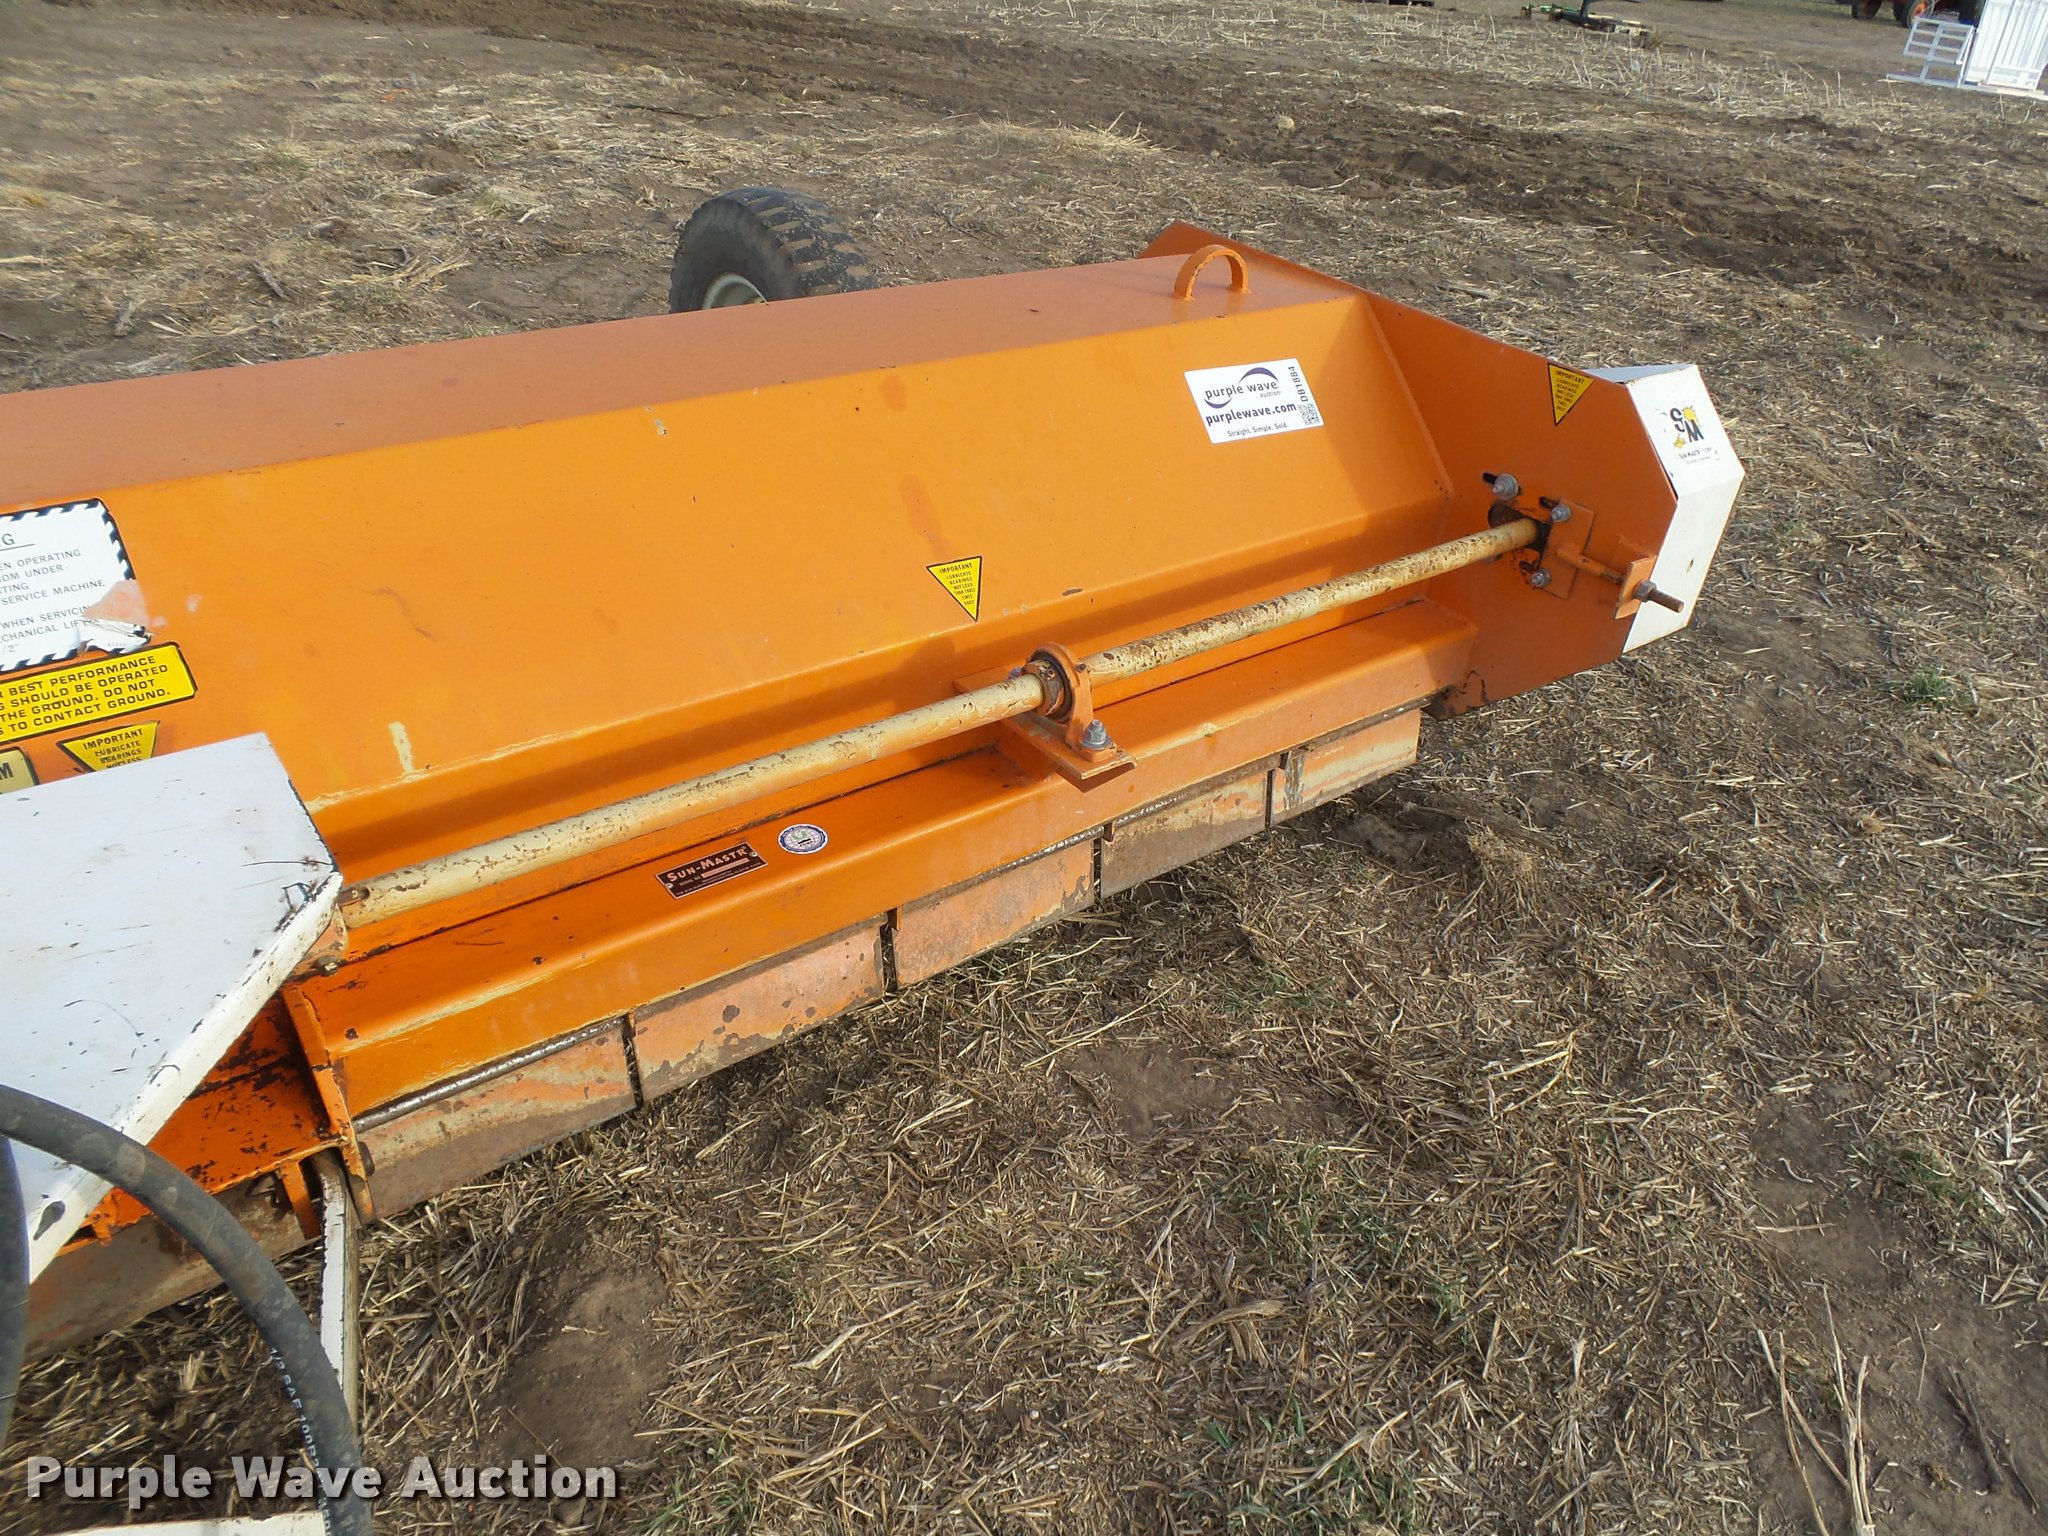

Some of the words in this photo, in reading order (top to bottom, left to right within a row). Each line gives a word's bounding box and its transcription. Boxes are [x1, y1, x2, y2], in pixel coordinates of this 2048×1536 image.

[1205, 385, 1244, 400] purple
[1247, 381, 1278, 392] wave
[1288, 366, 1309, 402] DB1884
[1205, 403, 1297, 427] purplewave.com
[16, 549, 82, 567] OPERATING
[939, 562, 973, 574] IMPORTANT
[24, 564, 64, 578] UNDER
[1, 589, 48, 605] SERVICE
[52, 579, 105, 595] MACHINE
[0, 624, 59, 643] CHANICAL
[1, 616, 34, 629] WHEN
[9, 681, 43, 696] BEST
[50, 656, 156, 686] PERFORMANCE
[11, 688, 69, 708] SHOULD
[75, 682, 92, 694] BE
[97, 664, 168, 687] OPERATED
[0, 708, 27, 721] THE
[31, 693, 99, 715] GROUND.
[104, 686, 122, 699] DO
[128, 678, 155, 693] NOT
[10, 721, 28, 733] TO
[33, 704, 101, 727] CONTACT
[108, 687, 170, 709] GROUND.
[83, 728, 143, 750] IMPORTANT
[95, 739, 141, 756] LUBRICATE
[100, 748, 142, 764] BEARINGS
[667, 848, 748, 882] SUN-MASTR
[283, 1374, 302, 1409] SAE
